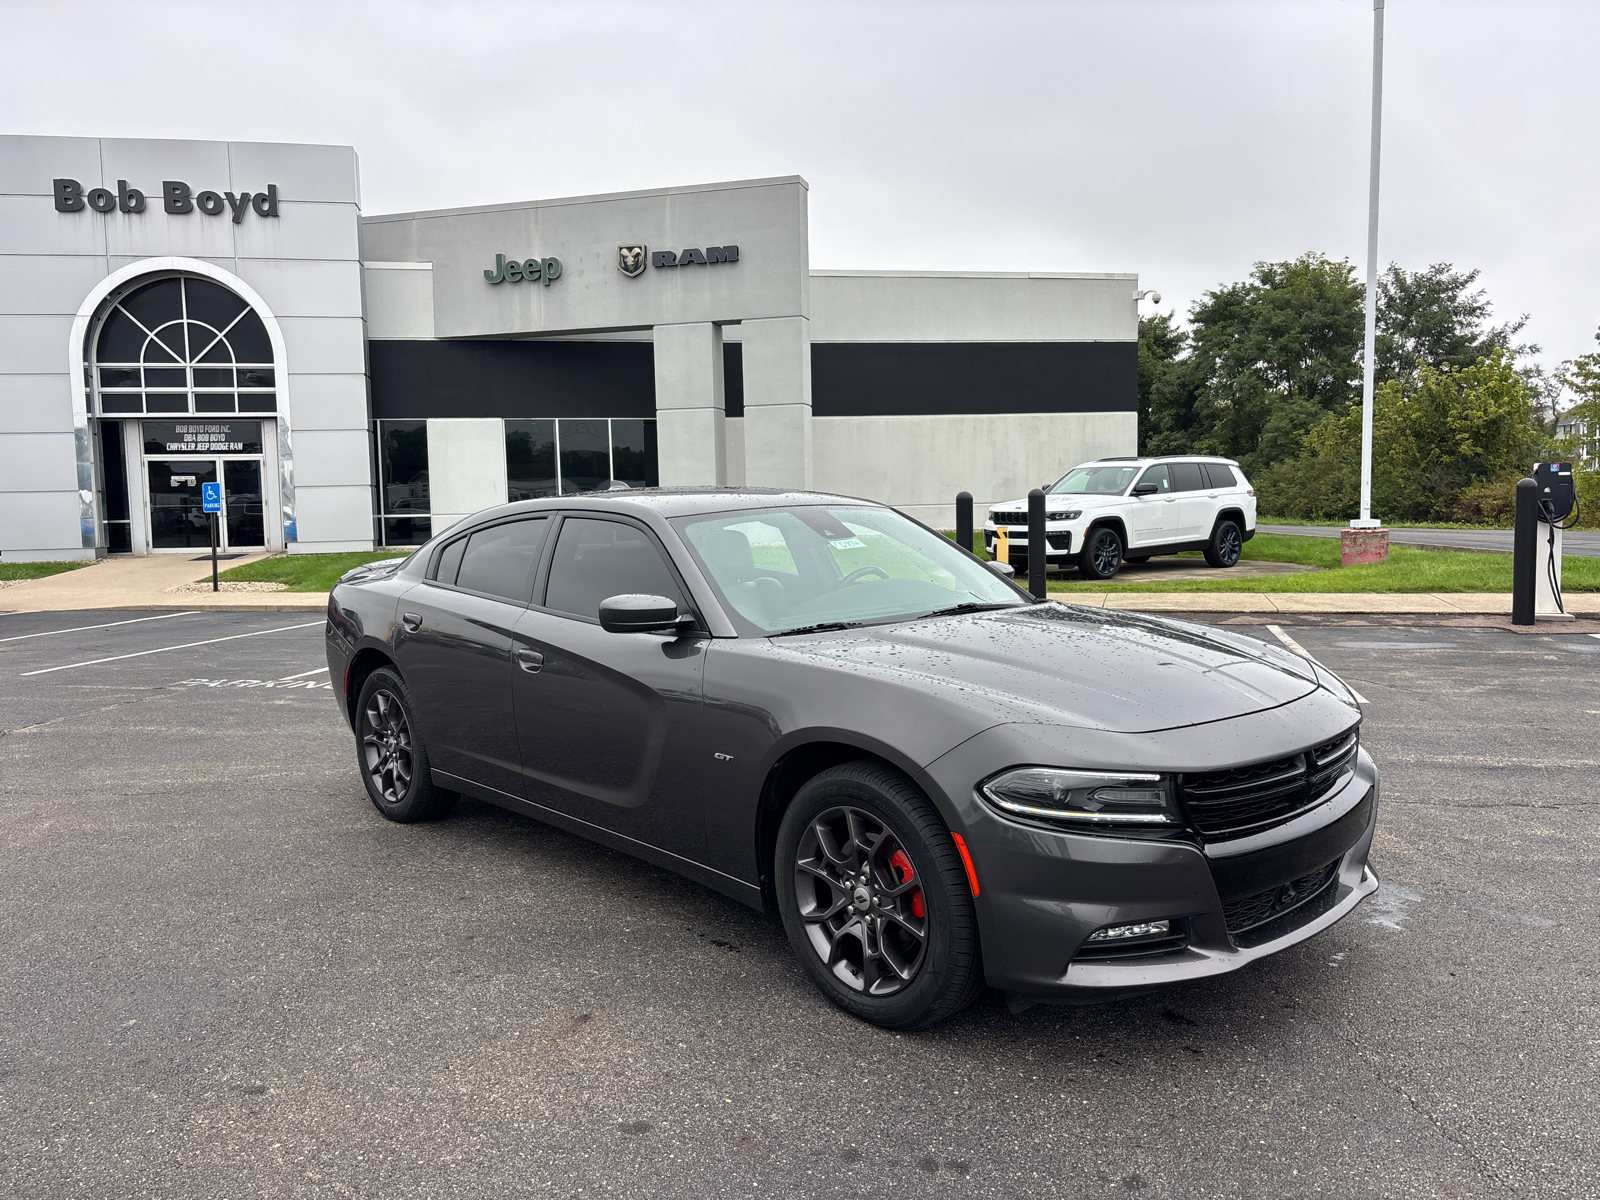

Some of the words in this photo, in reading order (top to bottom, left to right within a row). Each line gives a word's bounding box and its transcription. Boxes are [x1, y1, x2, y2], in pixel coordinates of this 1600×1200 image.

[53, 178, 146, 213] Bob
[162, 180, 280, 224] Boyd
[651, 245, 739, 267] RAM
[483, 253, 562, 286] Jeep
[175, 424, 188, 433] BOB
[188, 424, 204, 433] BOYD
[204, 424, 220, 433] FORD
[183, 433, 197, 442] DBA
[196, 433, 209, 442] BOB
[209, 433, 226, 442] BOYD
[166, 442, 196, 451] CHRYSLER
[195, 442, 210, 451] JEEP
[209, 442, 229, 451] DODGE
[229, 442, 243, 451] RAM
[713, 752, 735, 762] GT
[841, 787, 870, 800] GRAND
[874, 800, 909, 833] TOURING
